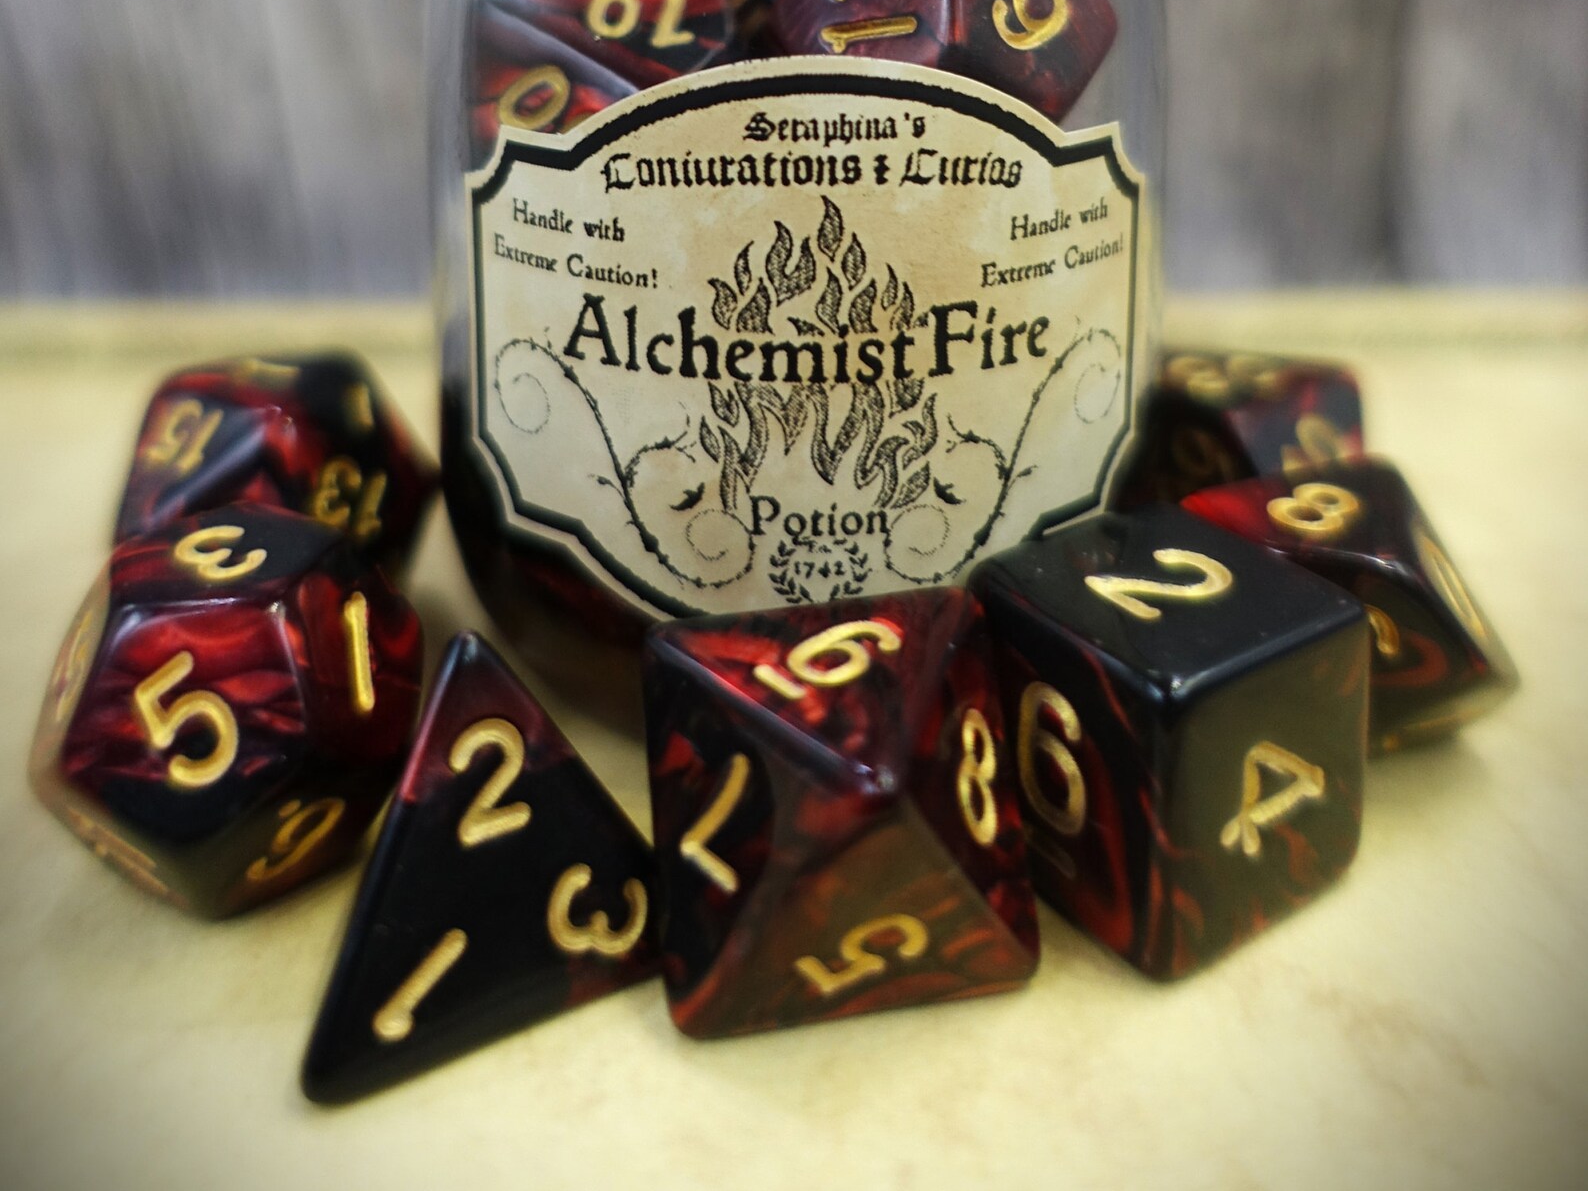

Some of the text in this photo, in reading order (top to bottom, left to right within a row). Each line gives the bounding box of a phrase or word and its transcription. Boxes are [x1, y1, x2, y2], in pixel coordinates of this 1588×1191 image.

[742, 111, 927, 148] Seraphina's
[898, 147, 1023, 189] Curios
[512, 197, 626, 243] Handle with
[1010, 197, 1109, 241] Handle with
[493, 233, 659, 289] Extreme Caution!
[980, 232, 1124, 288] Extreme Caution!
[563, 293, 1050, 384] Alchemist Fire
[750, 495, 892, 537] Potion
[1266, 482, 1360, 535] 8
[1083, 547, 1233, 620] 2
[344, 591, 375, 712] 1
[134, 651, 240, 787] 5
[448, 717, 532, 850] 2
[957, 708, 998, 847] 8
[1017, 681, 1087, 837] 6
[546, 862, 649, 957] 3
[373, 928, 468, 1042] 1
